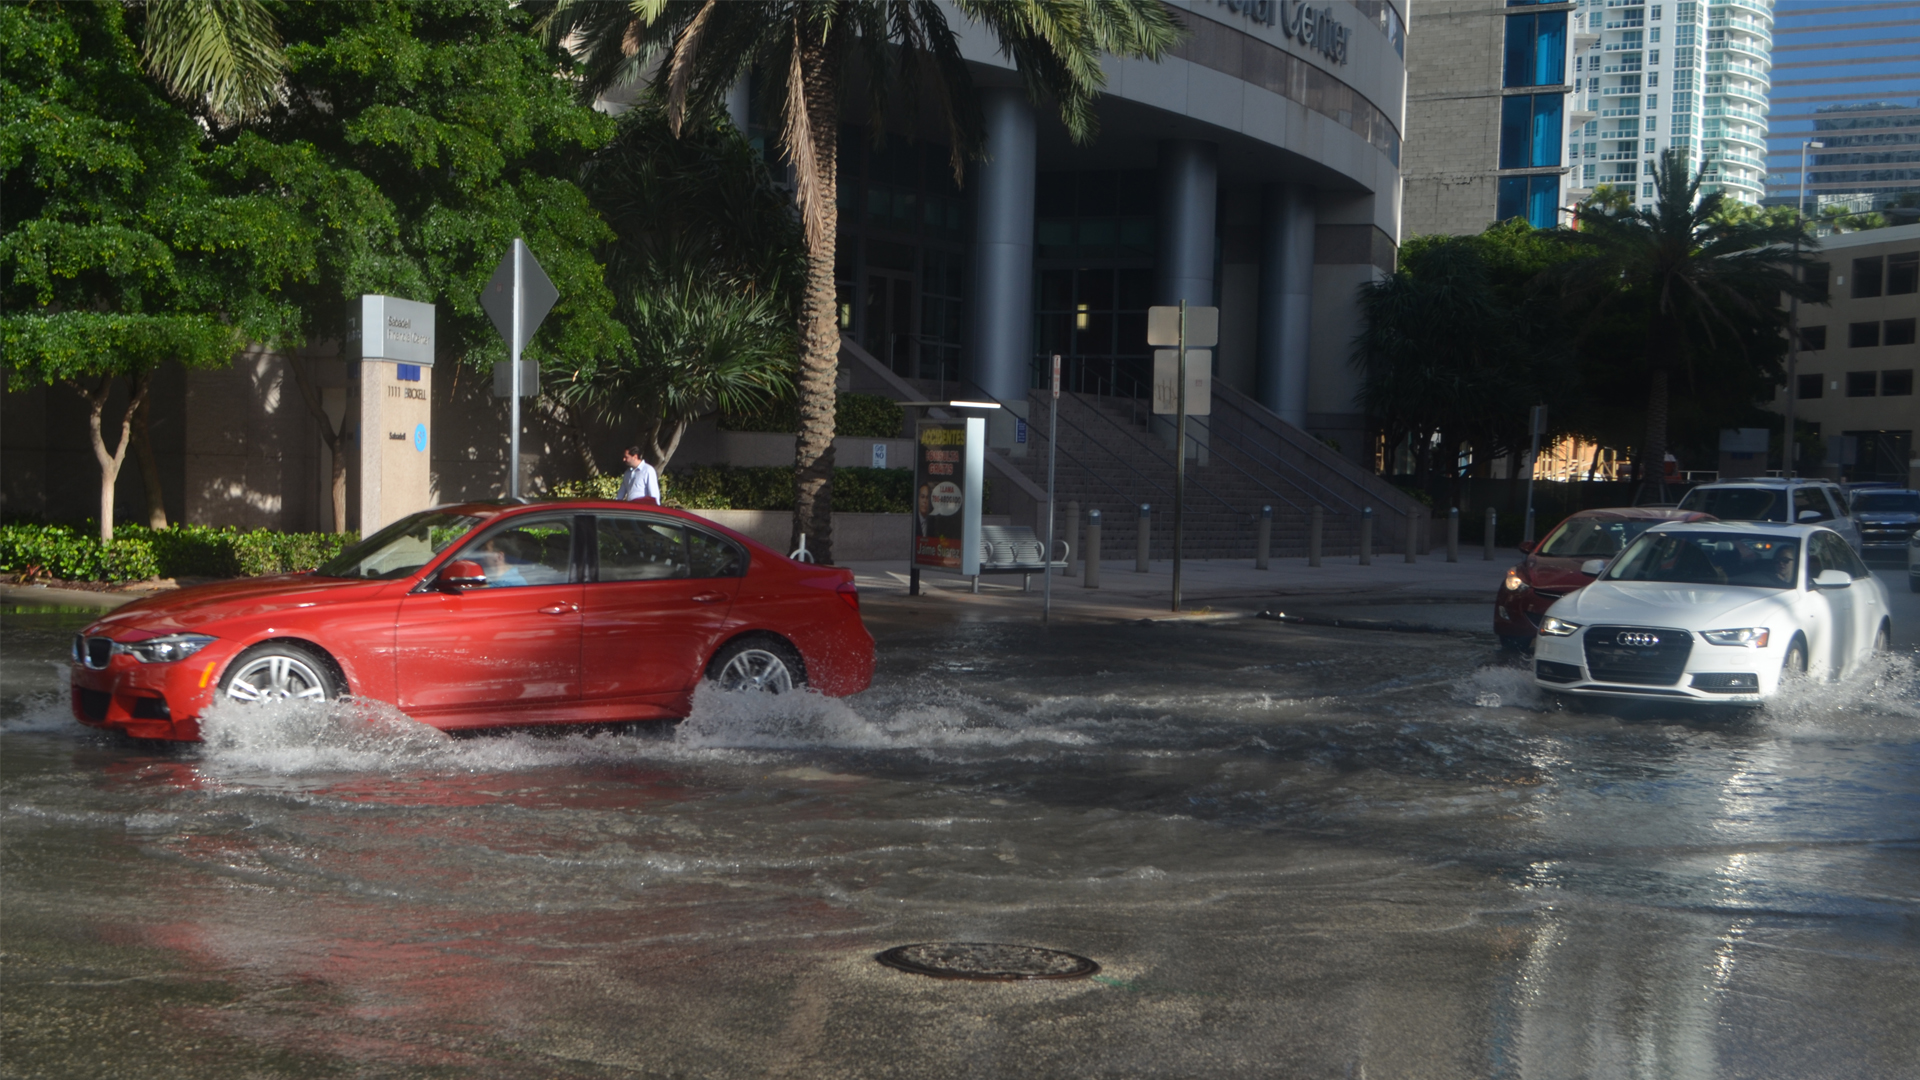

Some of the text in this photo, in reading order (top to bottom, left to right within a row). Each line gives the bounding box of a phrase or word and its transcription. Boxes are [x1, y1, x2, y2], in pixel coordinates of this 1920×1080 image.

[1281, 0, 1352, 65] Center
[388, 385, 401, 398] 1111
[921, 429, 965, 445] ACCIDENTES
[928, 463, 954, 475] GRATIS
[917, 542, 936, 556] Jaime
